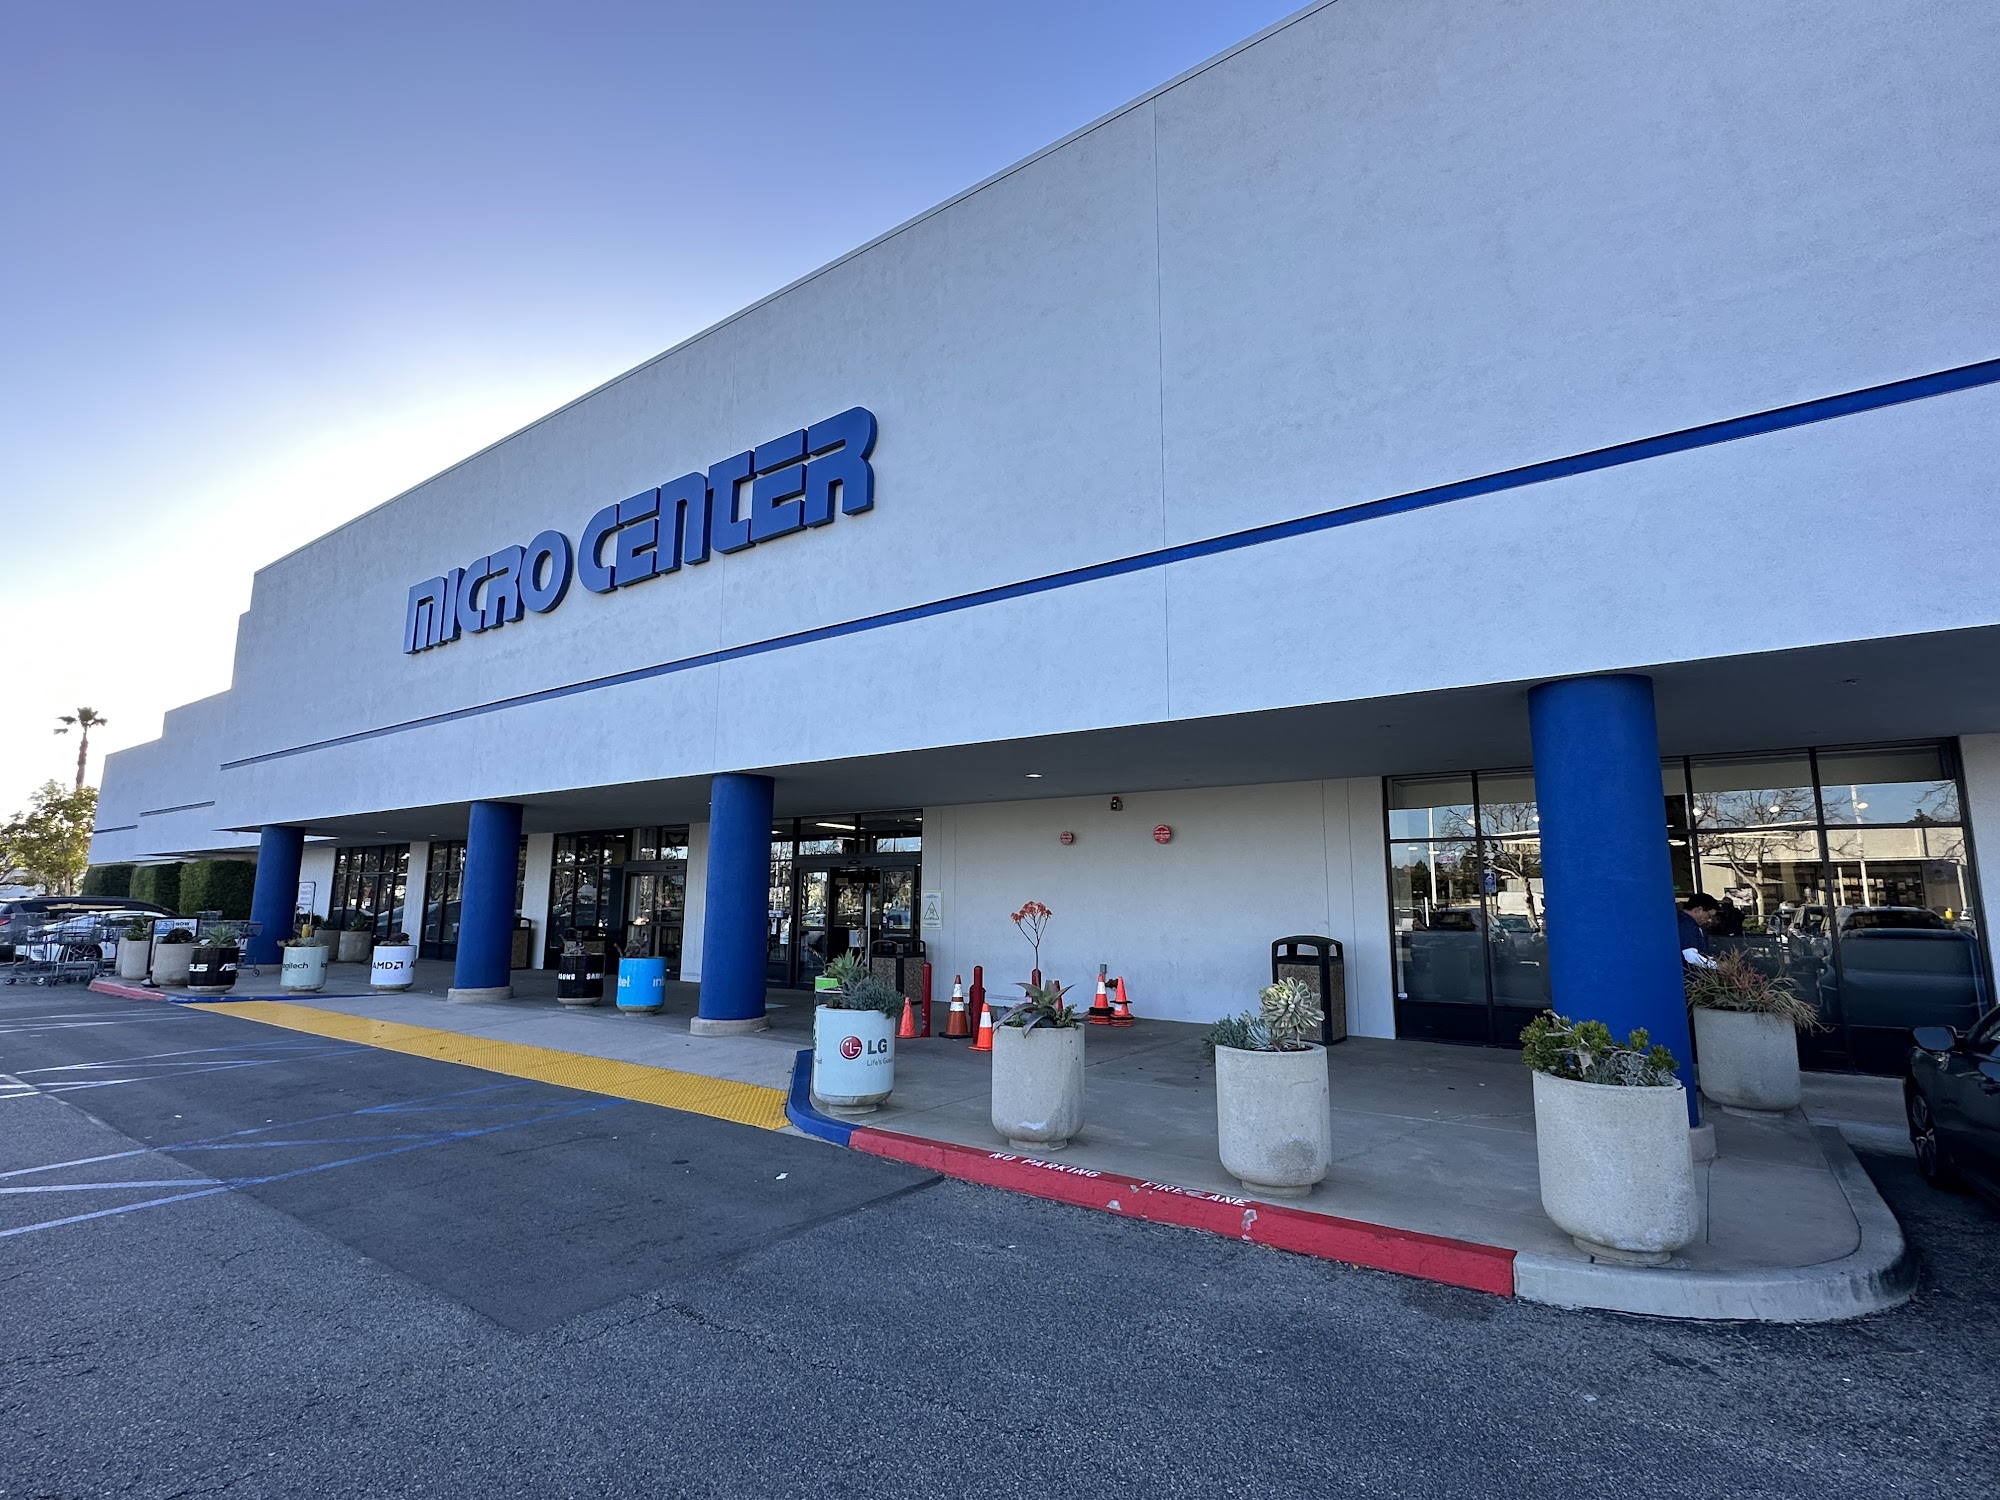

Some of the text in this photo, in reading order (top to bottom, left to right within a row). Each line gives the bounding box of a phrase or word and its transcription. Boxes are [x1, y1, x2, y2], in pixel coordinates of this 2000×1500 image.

[404, 406, 878, 655] MICRO CENTER
[282, 961, 309, 971] ogitech
[372, 961, 393, 970] AMD
[868, 1038, 887, 1054] LG
[989, 1151, 1101, 1179] NO PARKING
[1140, 1181, 1185, 1195] FIRE
